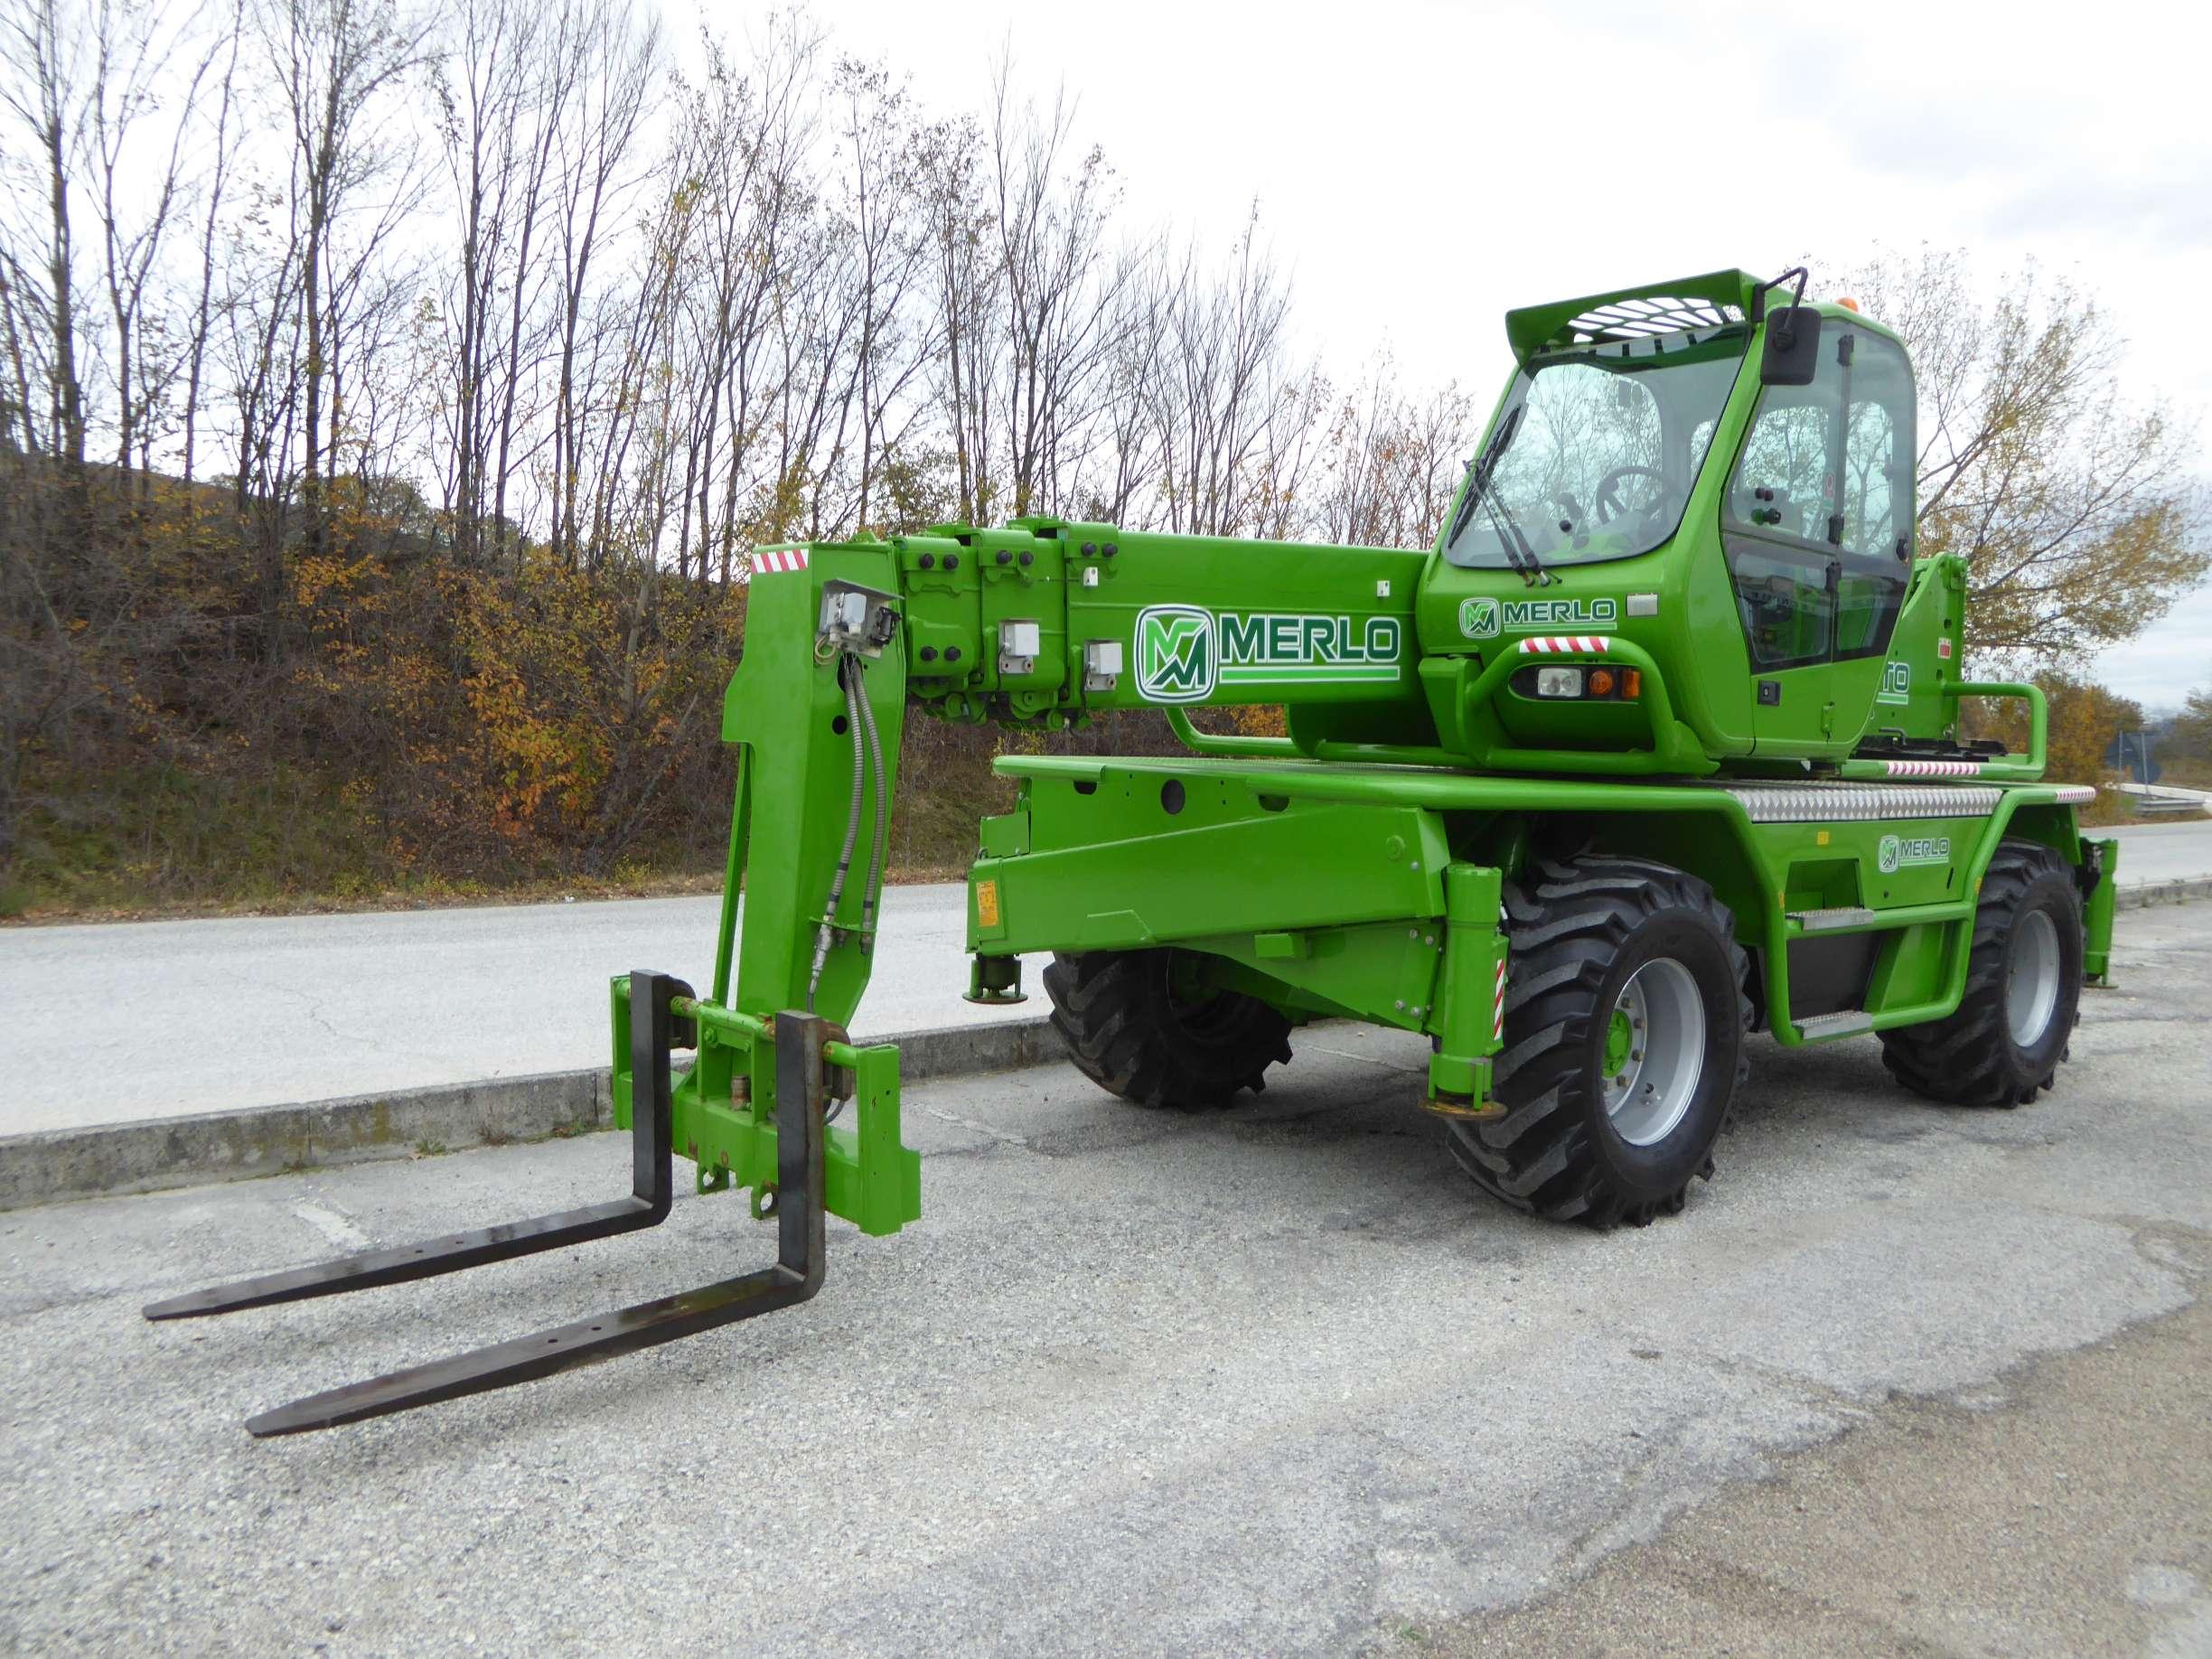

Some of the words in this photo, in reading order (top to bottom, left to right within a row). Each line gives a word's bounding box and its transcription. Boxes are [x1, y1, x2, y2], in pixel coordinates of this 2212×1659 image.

[1504, 597, 1617, 623] MERLO
[1220, 614, 1401, 663] MERLO
[1898, 837, 1950, 858] MERLO
